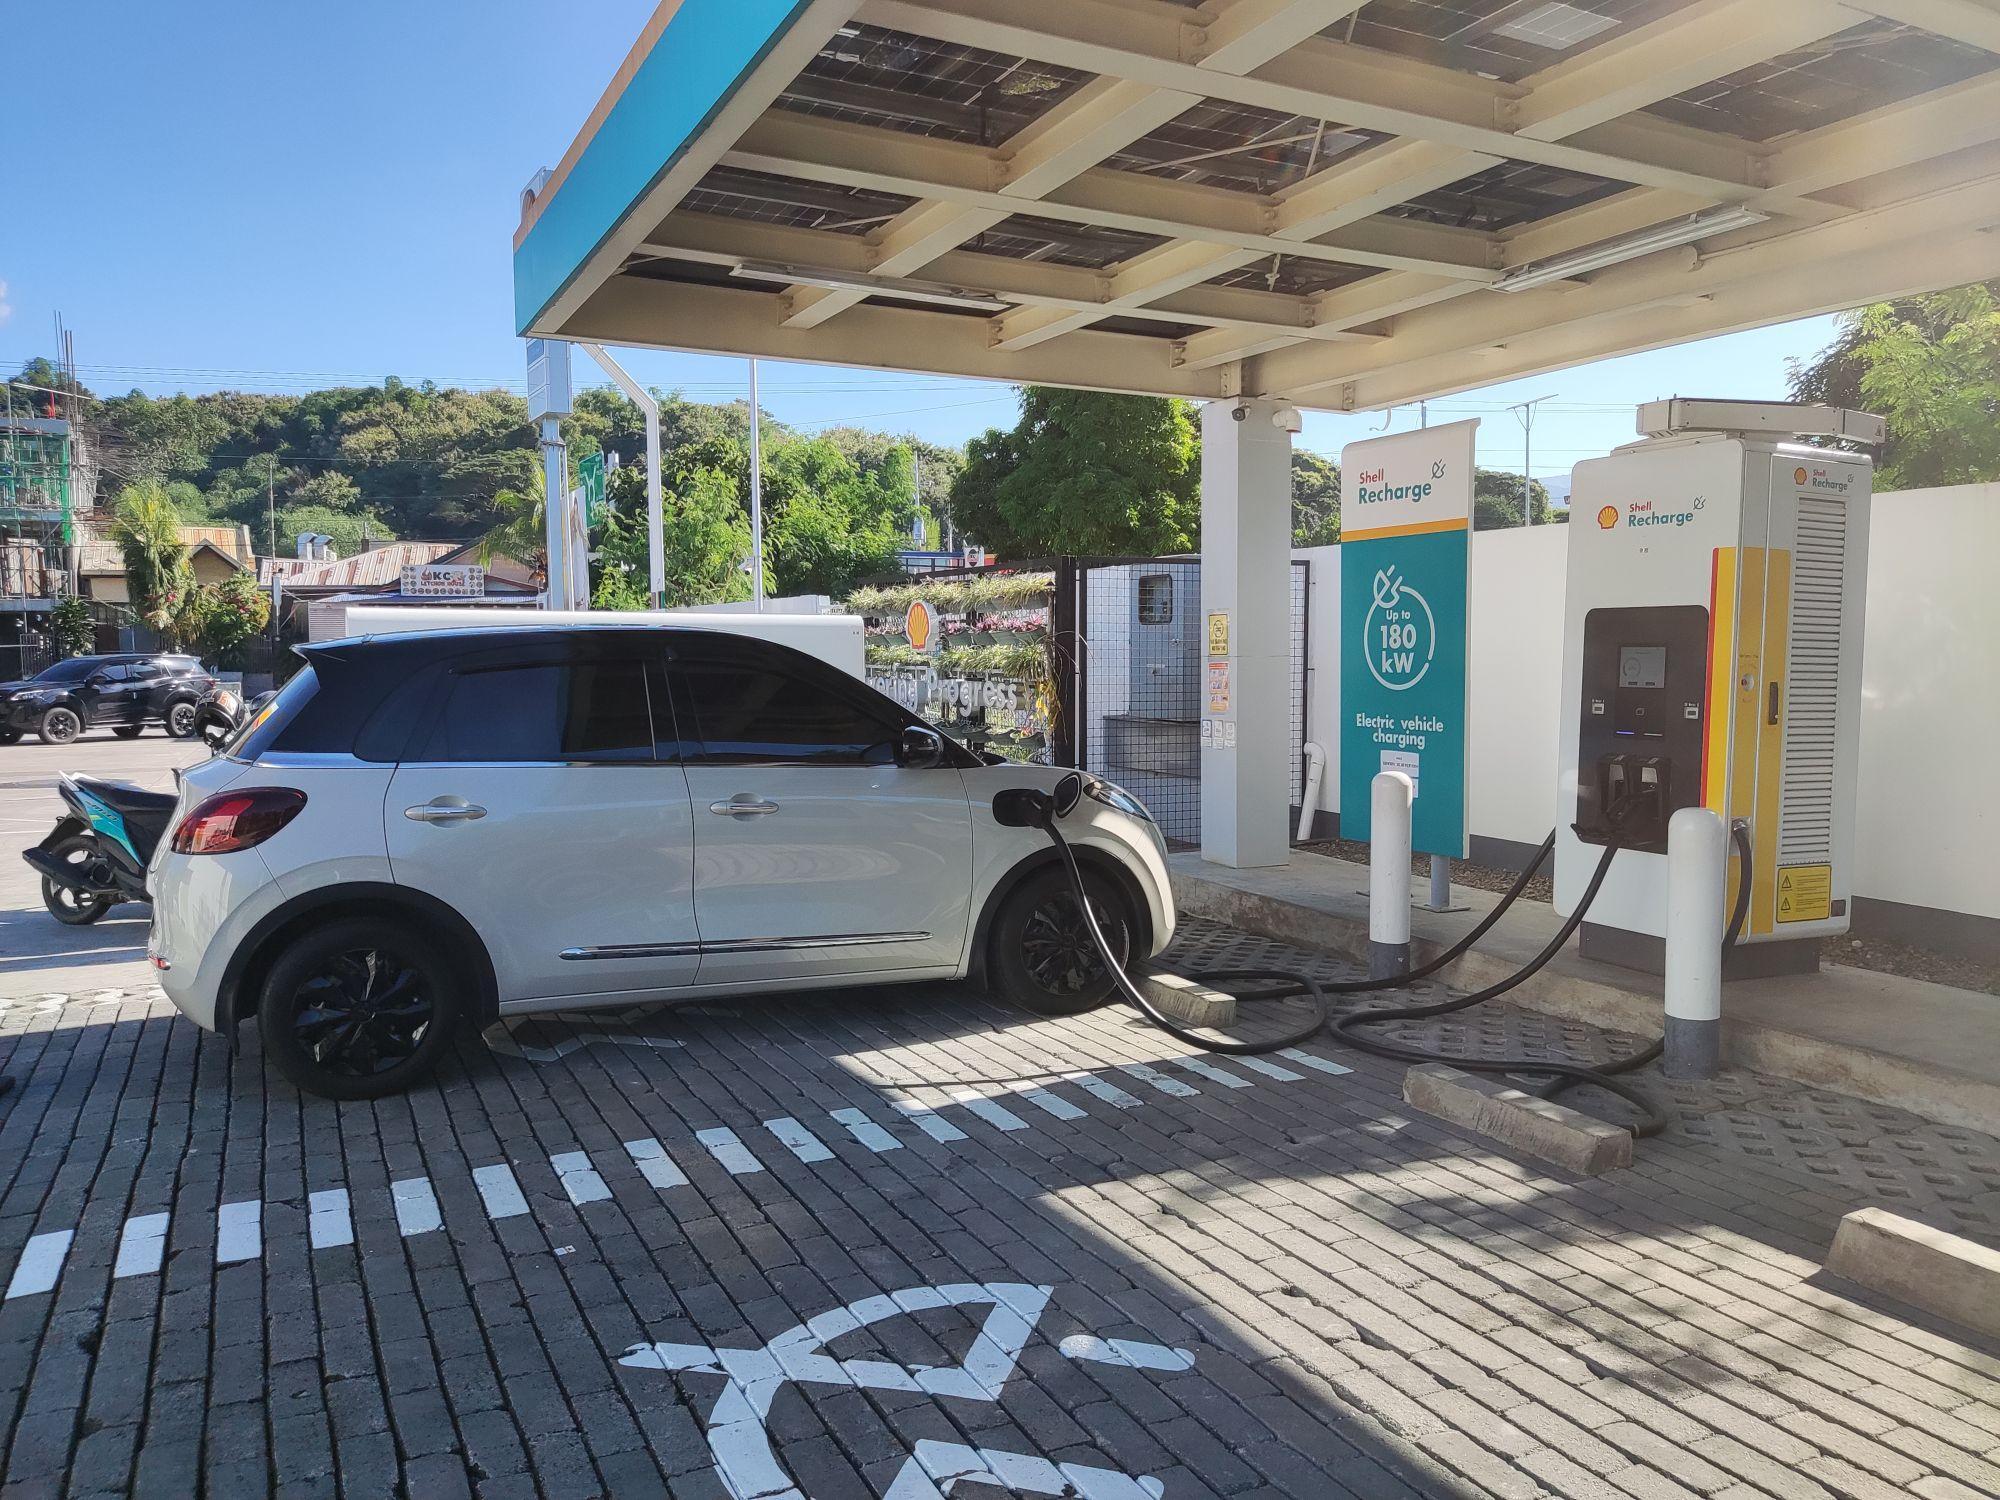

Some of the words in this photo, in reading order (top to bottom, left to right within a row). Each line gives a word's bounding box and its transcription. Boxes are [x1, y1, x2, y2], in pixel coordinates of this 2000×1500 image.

[1359, 468, 1384, 484] Shell
[1812, 477, 1848, 492] Recharge
[1358, 482, 1432, 504] Recharge
[1629, 501, 1652, 513] Shell
[1628, 511, 1694, 527] Recharge
[1386, 610, 1399, 621] Up
[1401, 610, 1411, 619] to
[1380, 624, 1417, 649] 180
[1381, 651, 1415, 674] kW
[927, 667, 1018, 717] Progress
[1356, 713, 1395, 729] Electric
[1400, 716, 1444, 732] vehicle
[1372, 730, 1426, 750] charging
